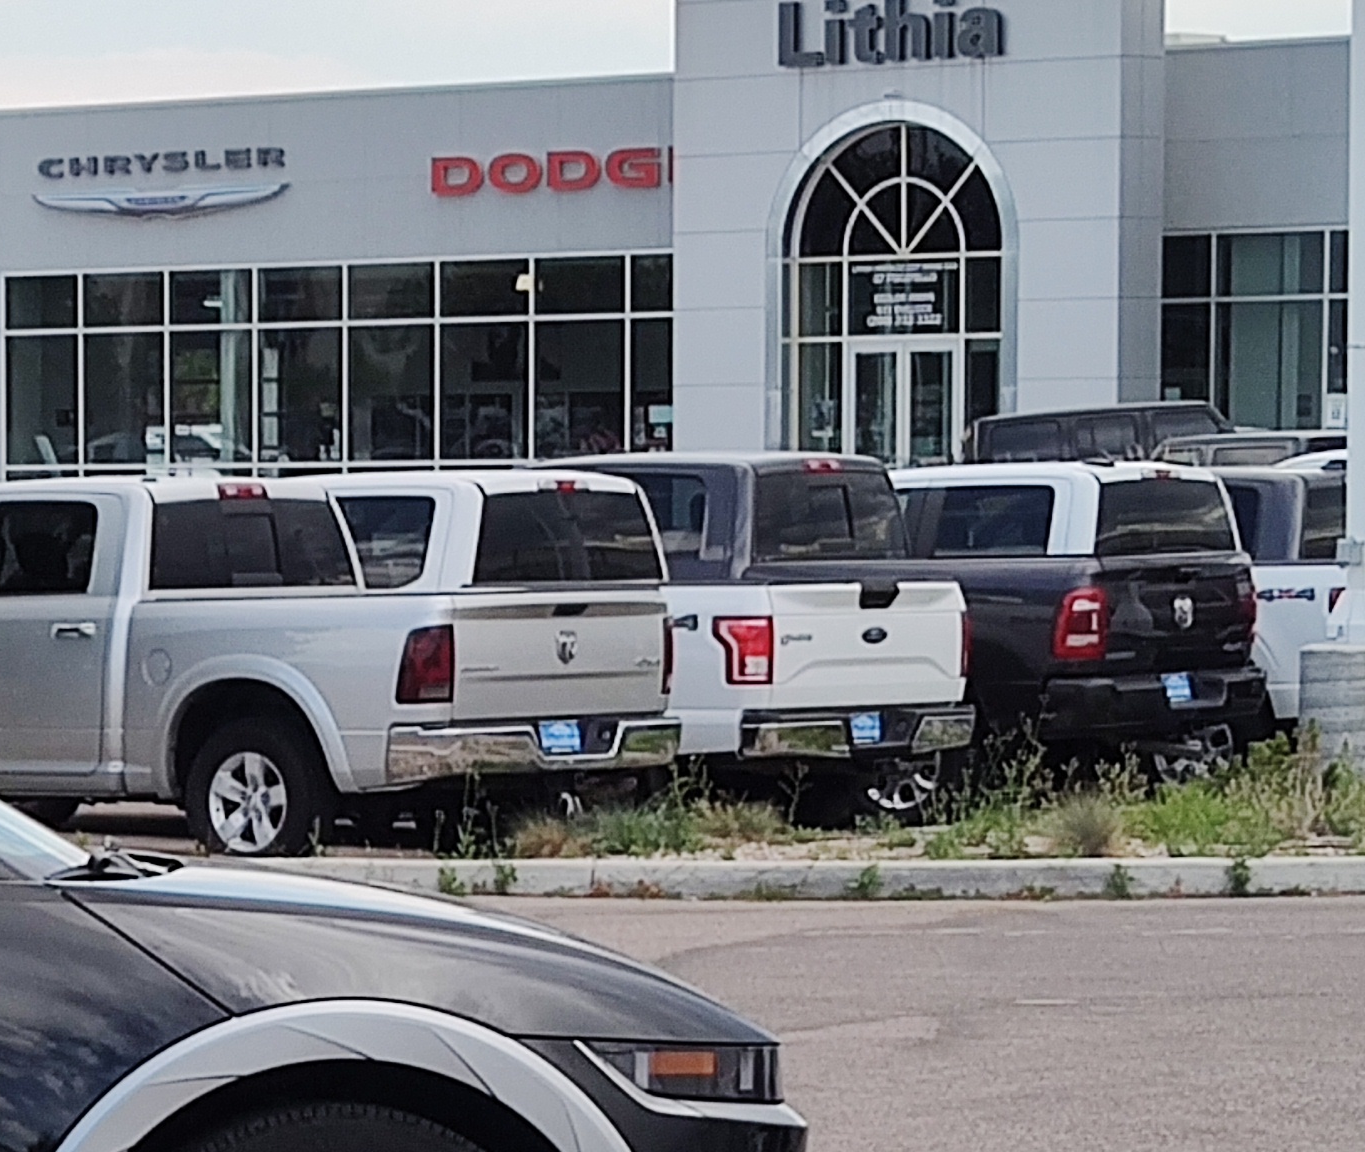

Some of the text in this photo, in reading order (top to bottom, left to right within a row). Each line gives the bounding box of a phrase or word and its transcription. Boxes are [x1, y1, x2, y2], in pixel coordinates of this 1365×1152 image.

[778, 0, 1005, 67] Lithia
[38, 147, 286, 179] CHRYSLER
[430, 146, 673, 197] DODG
